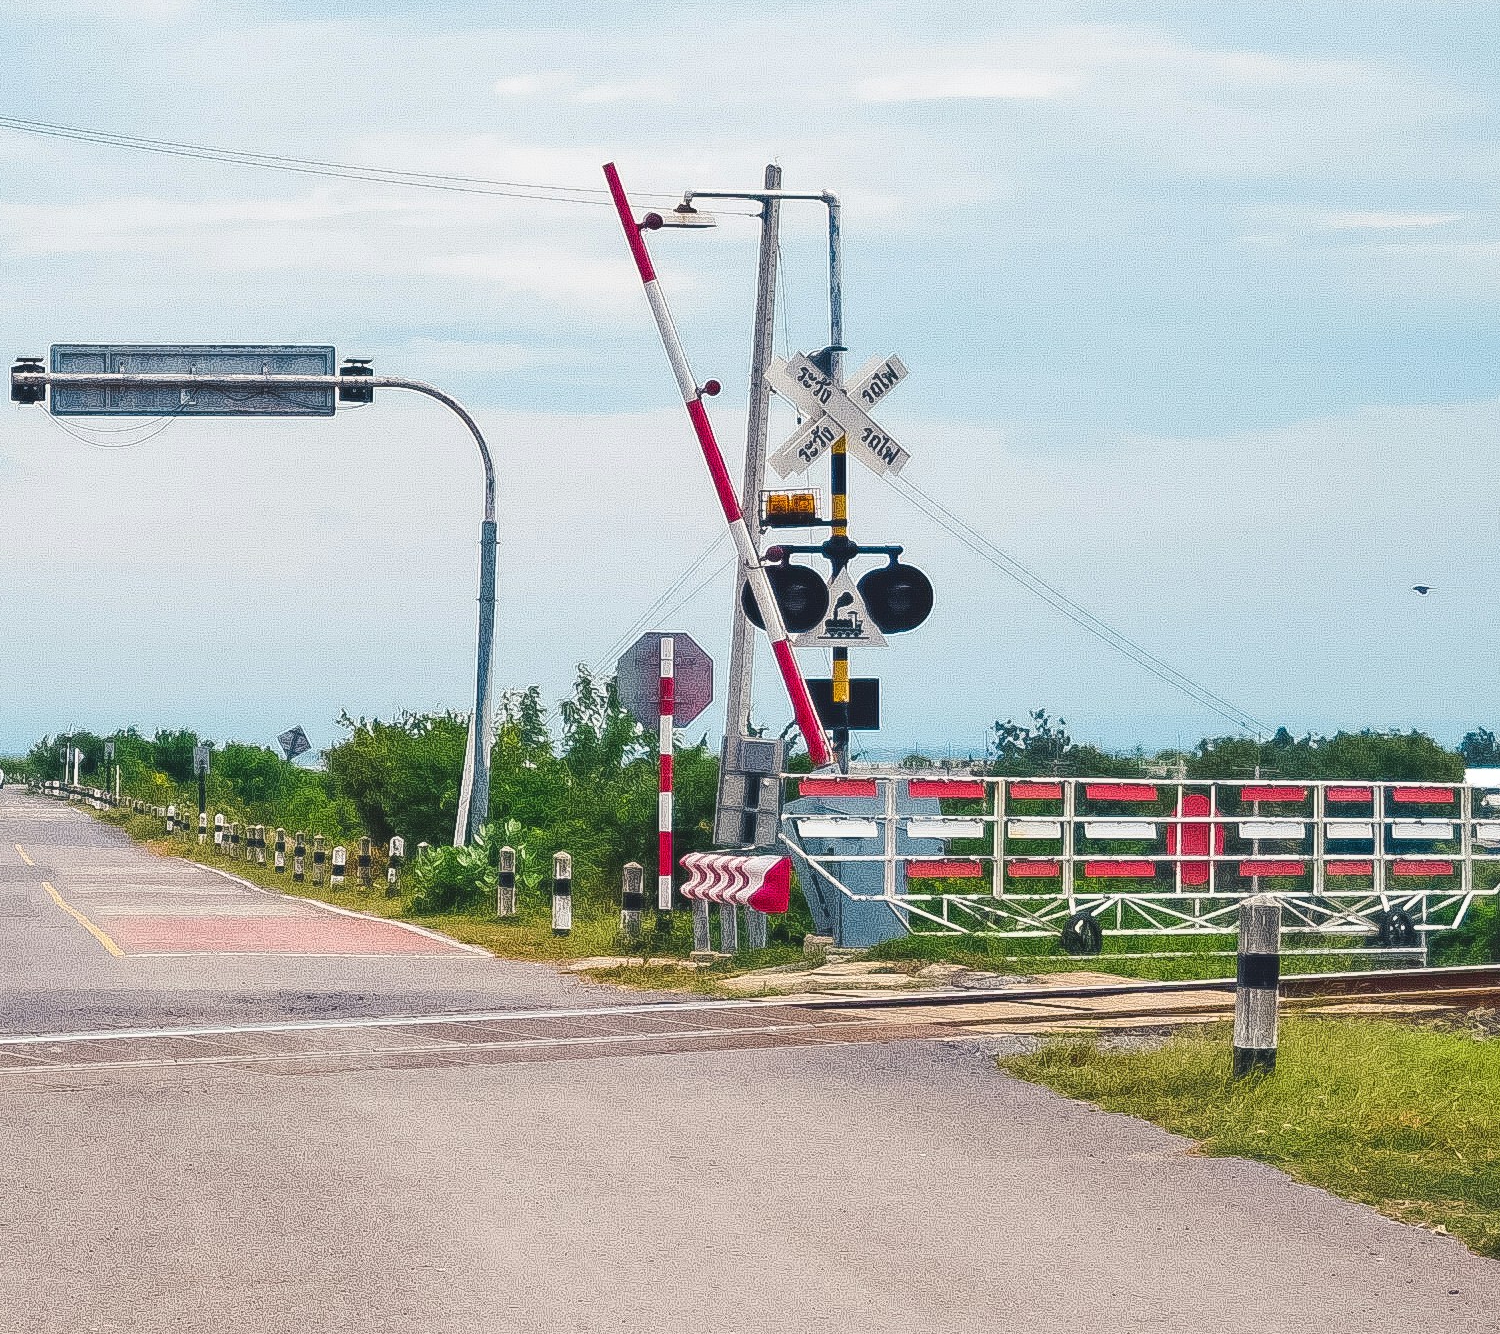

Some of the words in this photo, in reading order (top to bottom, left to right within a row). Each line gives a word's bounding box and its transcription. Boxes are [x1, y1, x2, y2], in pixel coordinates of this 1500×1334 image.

[799, 427, 834, 461] ระวัง
[863, 364, 898, 402] รถไฟ
[799, 367, 831, 403] ระวัง
[863, 428, 900, 464] รถไฟ
